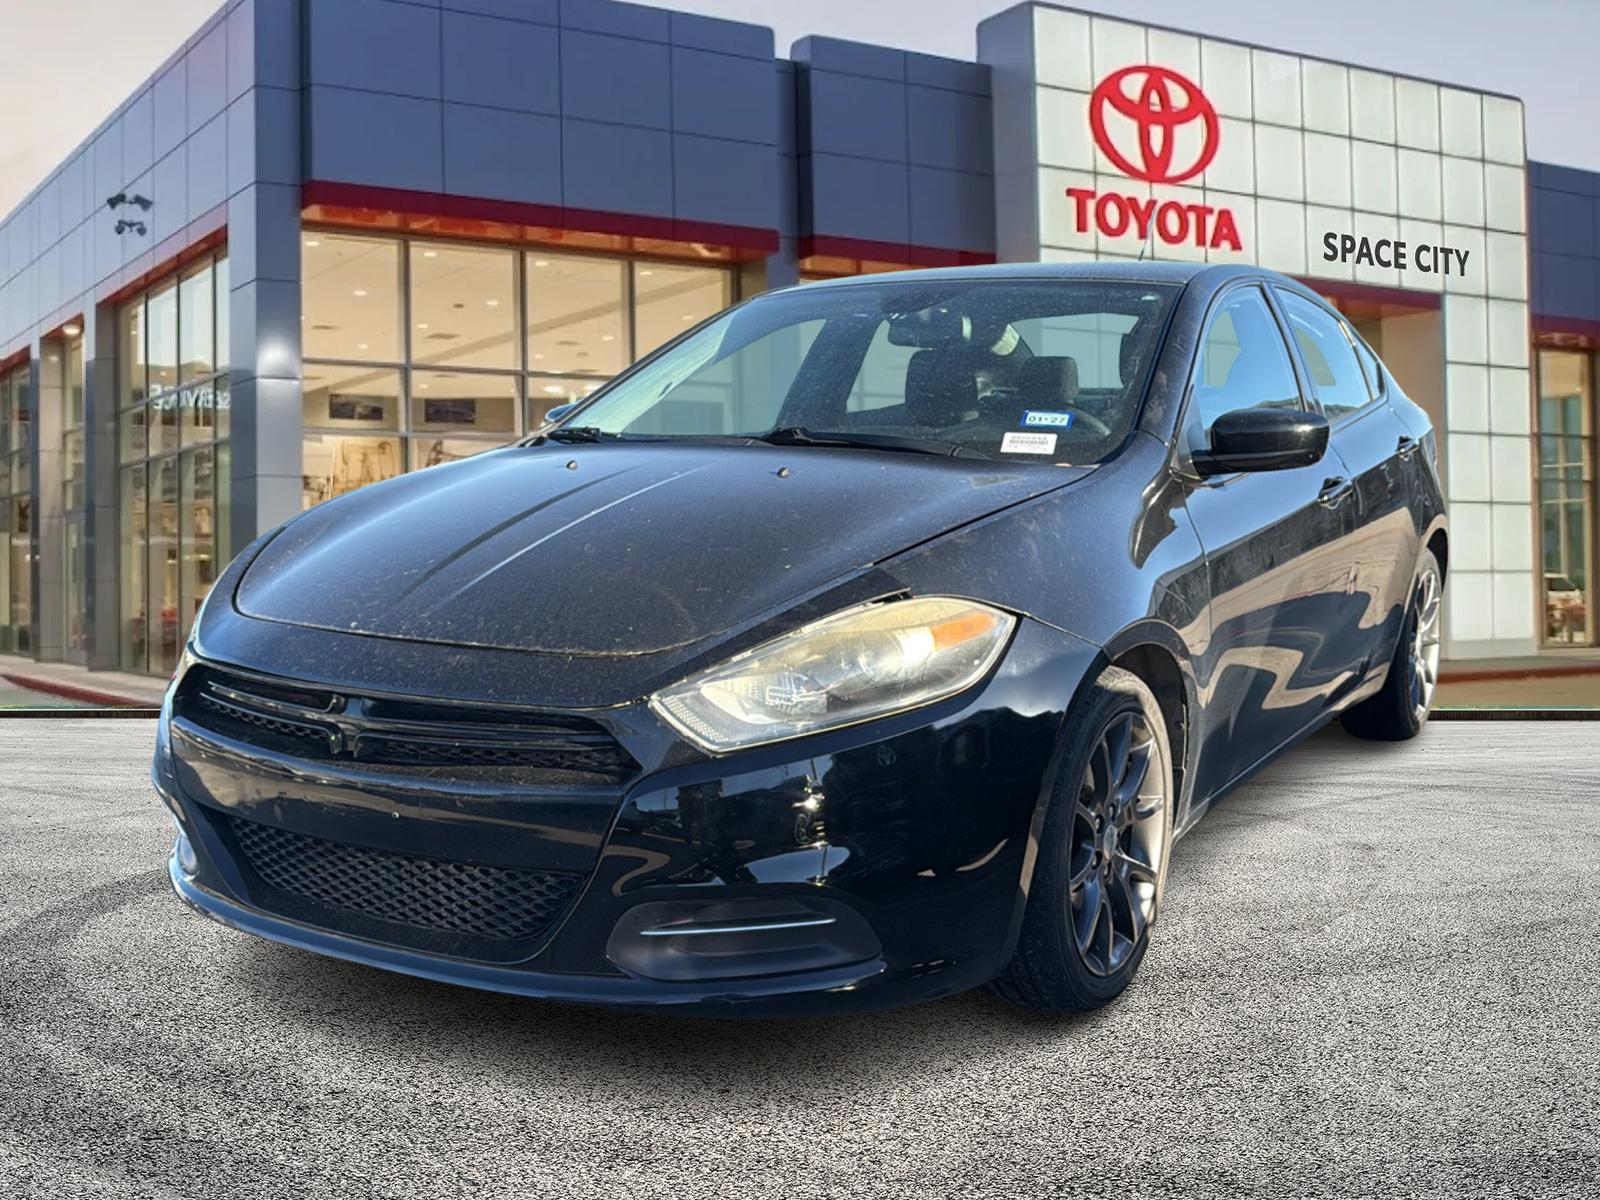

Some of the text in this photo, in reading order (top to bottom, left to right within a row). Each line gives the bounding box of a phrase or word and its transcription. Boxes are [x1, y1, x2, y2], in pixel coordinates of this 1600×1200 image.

[1065, 187, 1243, 251] TOYOTA
[1323, 231, 1470, 277] SPACE CITY
